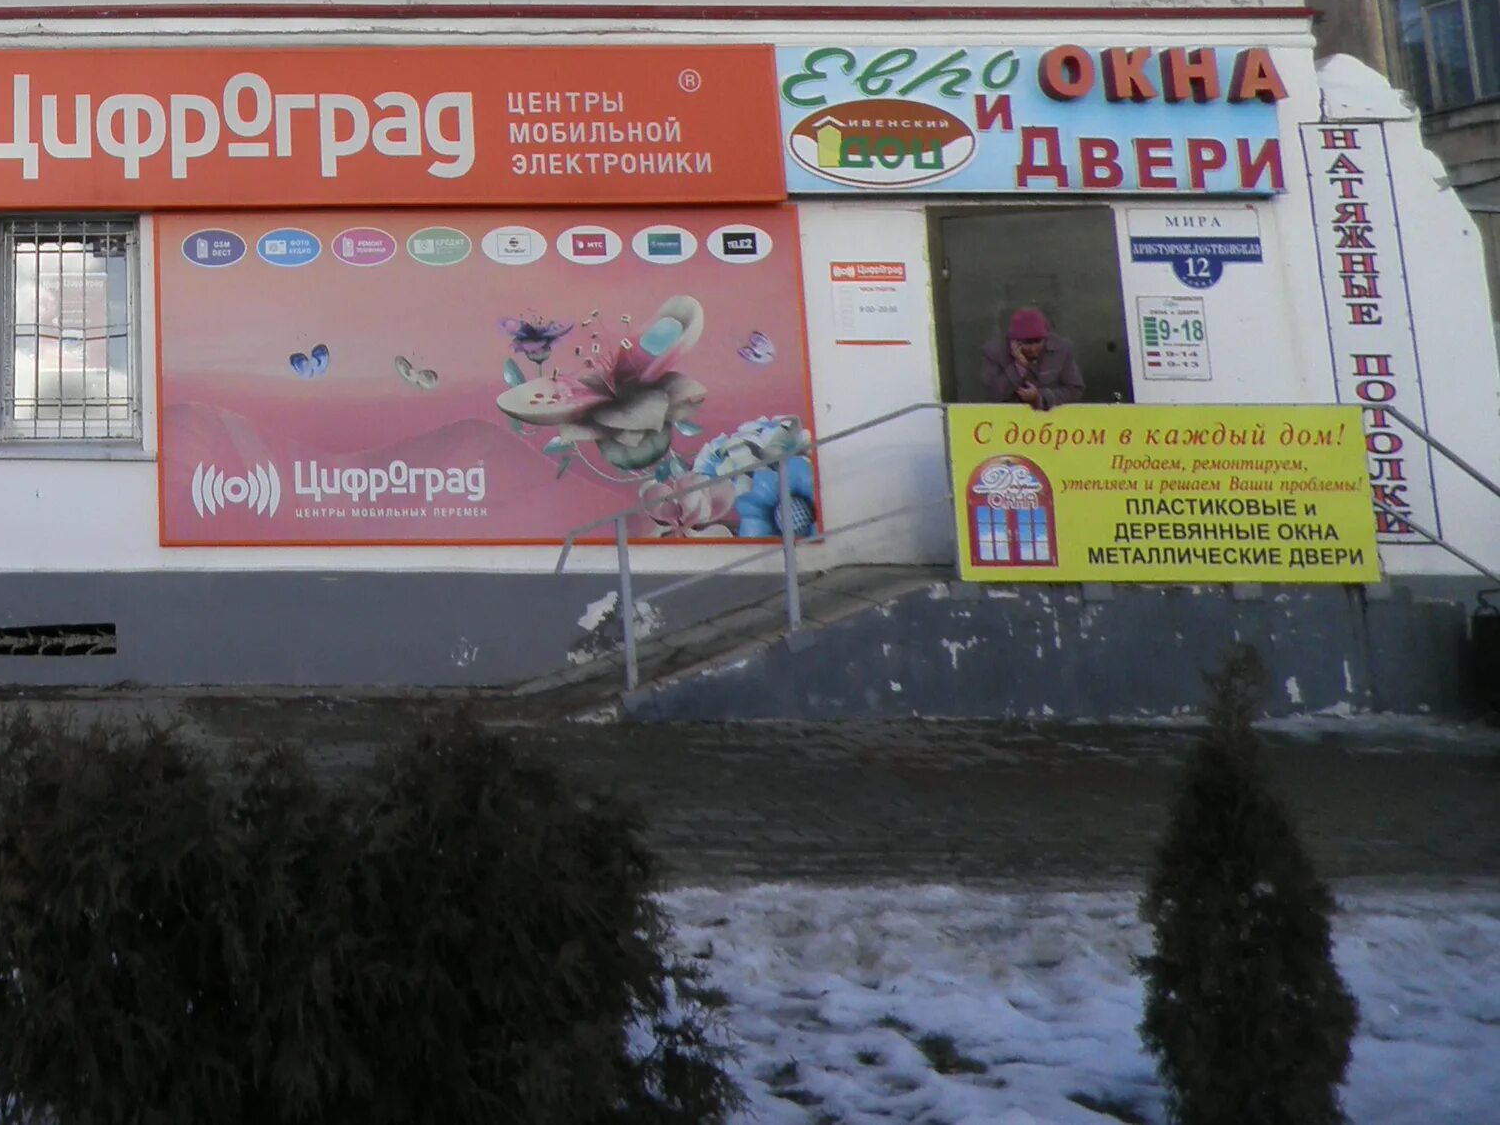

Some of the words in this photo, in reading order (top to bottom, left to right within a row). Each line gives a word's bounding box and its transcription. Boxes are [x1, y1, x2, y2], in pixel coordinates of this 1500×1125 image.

[782, 47, 1020, 107] Евро
[1038, 44, 1290, 103] ОКНА
[507, 92, 624, 115] ЦЕНТРЫ
[509, 116, 681, 144] МОБИЛЬНОЙ
[511, 152, 712, 175] ЭЛЕКТРОНИКИ
[1016, 127, 1285, 189] ДВЕРИ
[1164, 215, 1221, 228] МИРА
[1320, 128, 1383, 325] НАТЯЖНЫЕ
[213, 241, 231, 249] GSM
[727, 239, 754, 251] TELE2
[1185, 257, 1211, 277] 12
[1159, 319, 1204, 342] 9-18
[973, 421, 993, 445] С
[1004, 422, 1105, 450] добром
[1119, 428, 1132, 445] в
[1146, 422, 1265, 446] каждый
[1280, 422, 1345, 446] дом!
[1111, 454, 1185, 473] Продаем,
[1192, 457, 1308, 474] ремонтируем,
[1061, 478, 1137, 493] утепляем
[1144, 479, 1153, 491] и
[1159, 479, 1220, 493] решаем
[1228, 476, 1274, 491] Ваши
[1280, 477, 1363, 494] проблемы!
[295, 508, 346, 518] ЦЕНТРЫ
[351, 507, 427, 518] МОБИЛЬНЫХ
[433, 506, 488, 516] ПЕРЕМЕН
[1126, 498, 1297, 516] ПЛАСТИКОВЫЕ
[1304, 503, 1317, 516] и
[1114, 523, 1270, 543] ДЕРЕВЯННЫЕ
[1278, 524, 1339, 541] ОКНА
[1088, 547, 1282, 566] МЕТАЛЛИЧЕСКИЕ
[1289, 549, 1364, 568] ДВЕРИ
